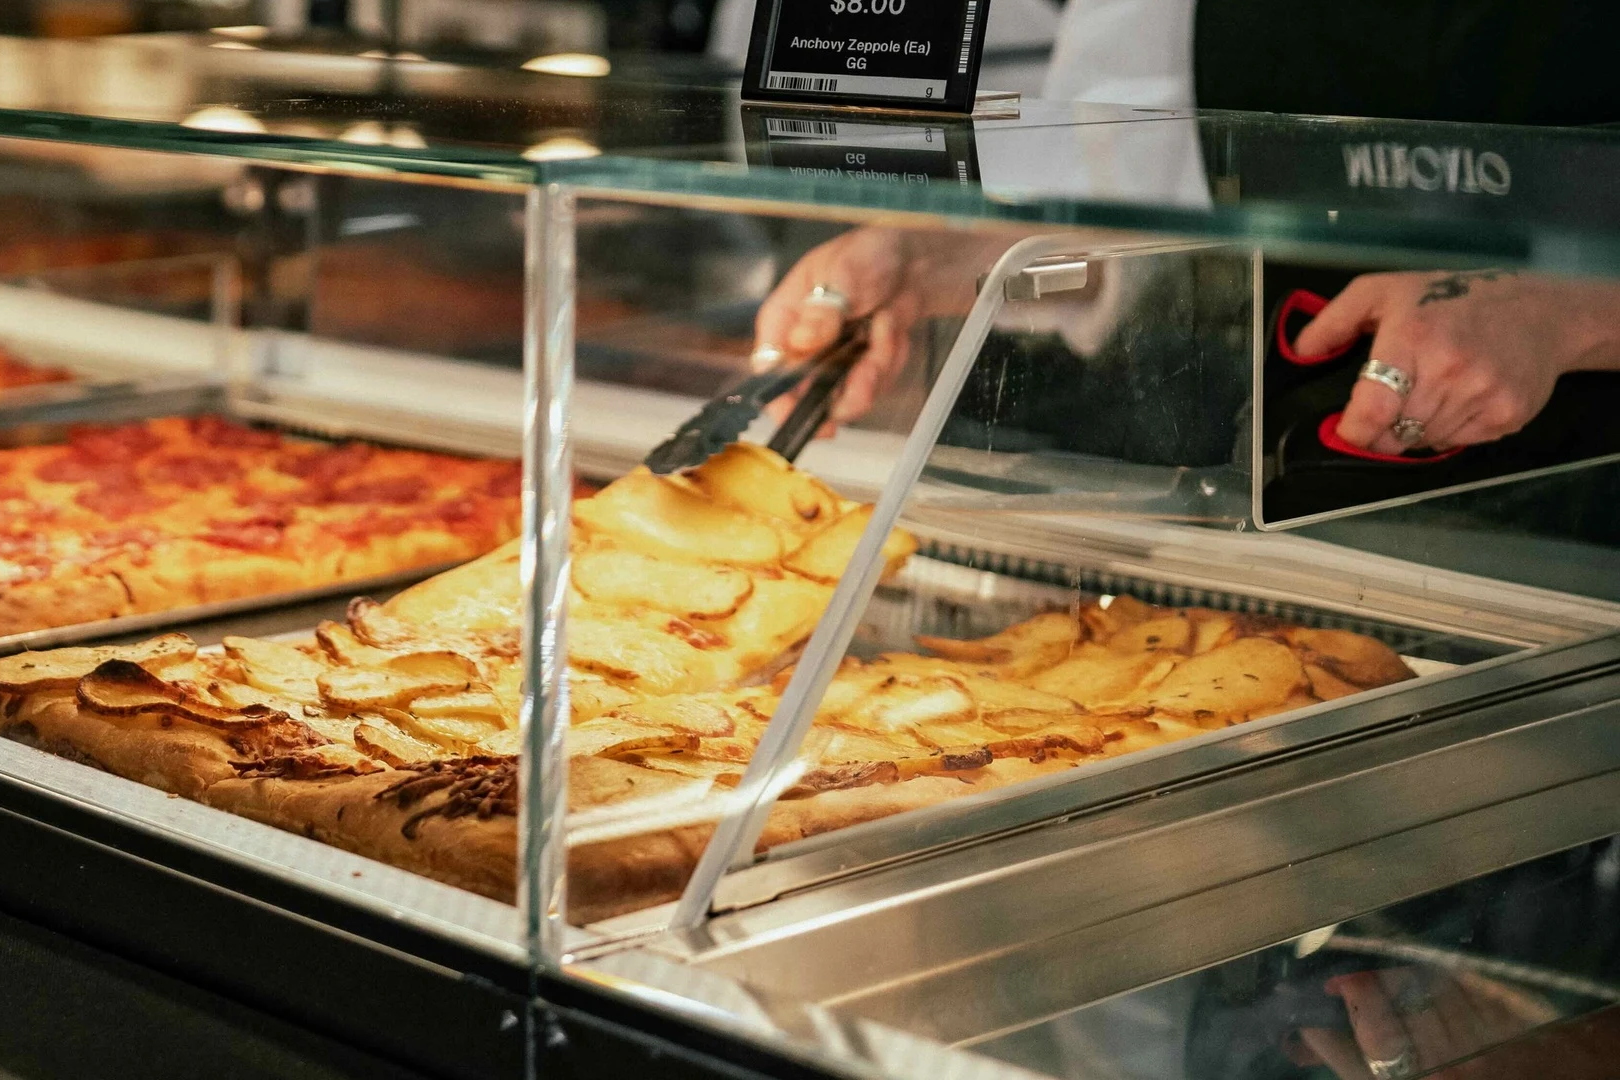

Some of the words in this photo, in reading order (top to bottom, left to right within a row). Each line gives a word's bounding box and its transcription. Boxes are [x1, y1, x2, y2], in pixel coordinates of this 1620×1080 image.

[790, 36, 845, 52] Anchovy
[847, 38, 901, 54] Zeppole
[903, 39, 931, 56] (Ea)
[845, 56, 867, 70] GG
